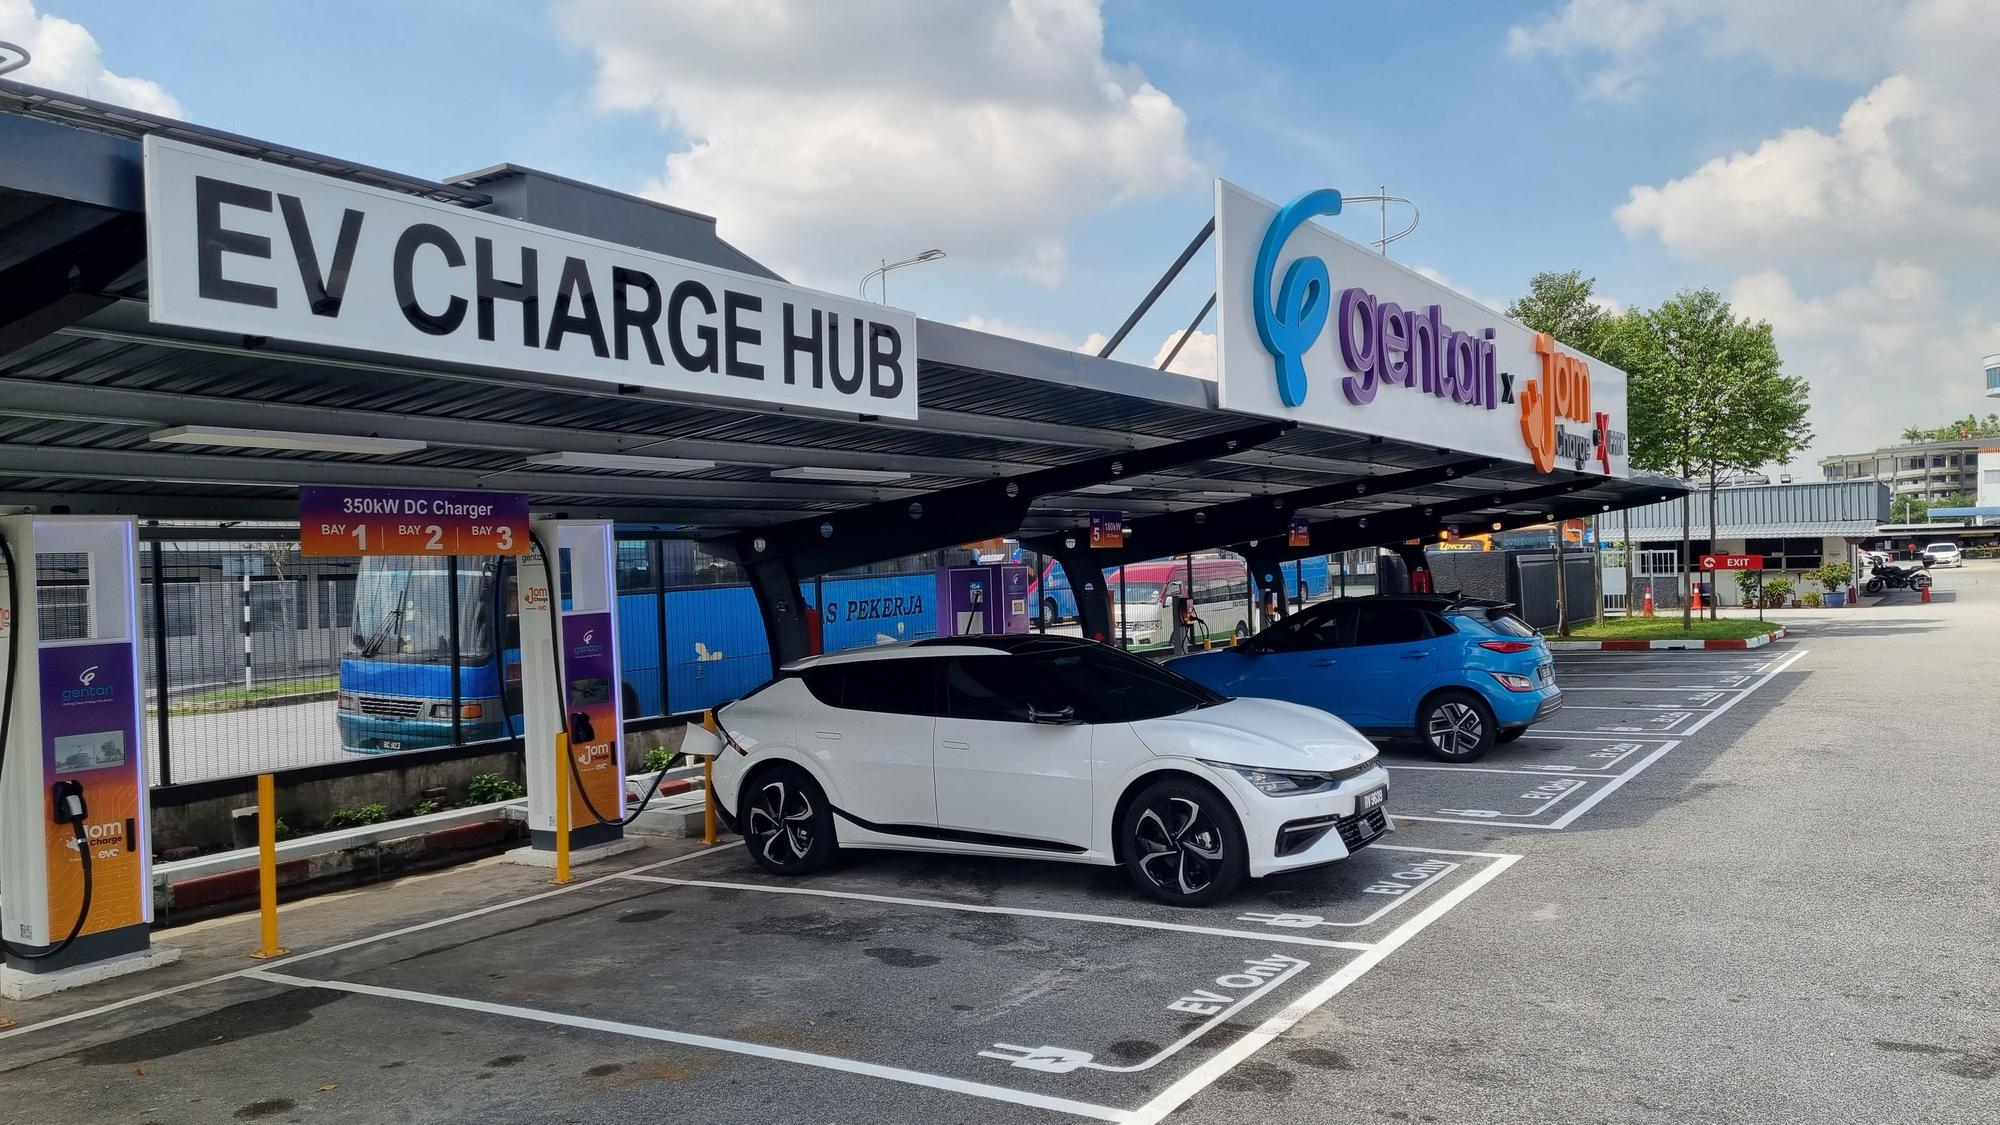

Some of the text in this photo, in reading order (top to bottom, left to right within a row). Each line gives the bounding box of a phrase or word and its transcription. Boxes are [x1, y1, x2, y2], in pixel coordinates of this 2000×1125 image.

[196, 175, 903, 399] EV CHARGE HUB
[1339, 287, 1497, 410] gentari
[1520, 332, 1590, 473] Jom
[1554, 424, 1591, 470] Charge
[343, 498, 493, 518] 350kW DC Charger
[321, 524, 366, 550] BAY 1
[398, 525, 443, 550] BAY 2
[471, 526, 513, 550] BAY 3
[1093, 527, 1100, 541] 5
[1727, 558, 1750, 567] EXIT
[846, 595, 922, 621] PEKERJA
[98, 848, 119, 859] evc
[1362, 859, 1453, 894] EV Only
[1166, 953, 1297, 1015] EV Only
